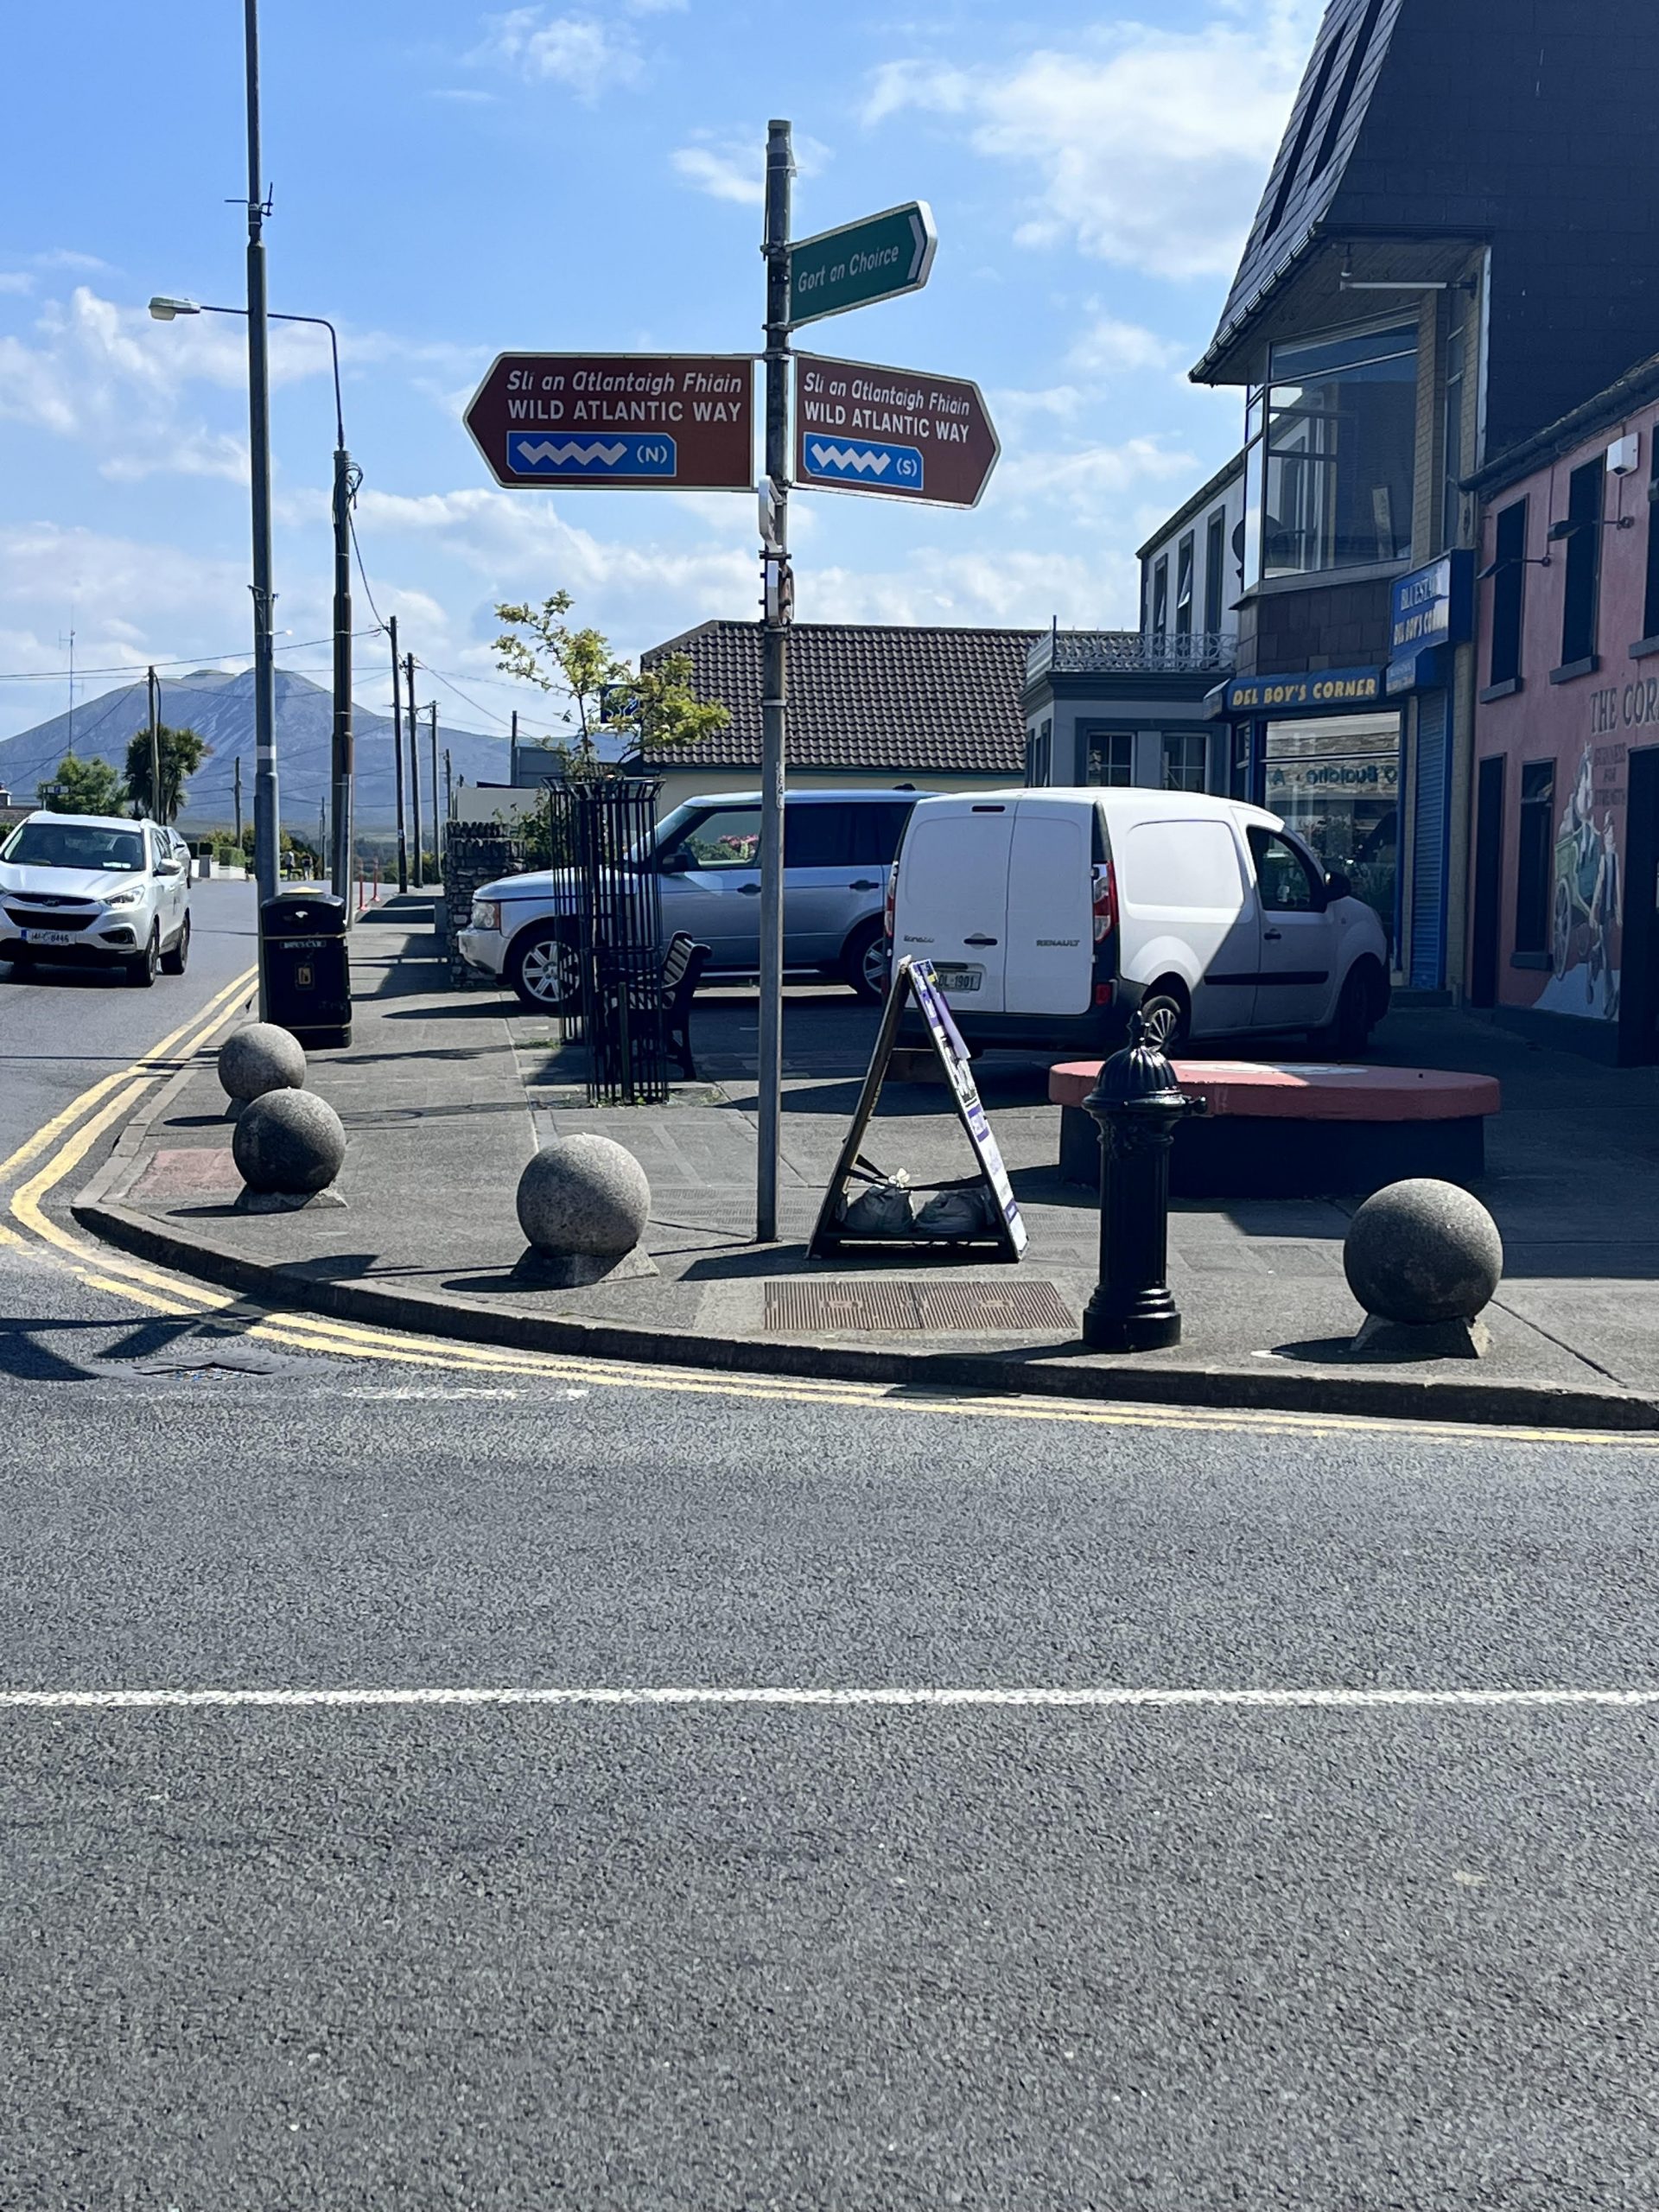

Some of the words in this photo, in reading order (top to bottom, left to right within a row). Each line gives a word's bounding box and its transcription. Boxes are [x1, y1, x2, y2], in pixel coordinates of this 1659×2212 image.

[798, 264, 826, 293] Gort
[830, 264, 845, 283] an
[849, 245, 899, 276] Choirce
[506, 371, 533, 391] Slí
[541, 375, 564, 391] an
[572, 372, 674, 396] Atlantaigh
[683, 372, 742, 393] Fhiáin
[804, 372, 824, 393] Slí
[830, 380, 847, 398] an
[851, 379, 925, 411] Atlantaigh
[928, 391, 969, 416] Fhiáin
[507, 399, 564, 420] WILD
[573, 400, 683, 422] ATLANTIC
[692, 402, 742, 422] WAY
[804, 400, 846, 425] WILD
[851, 408, 930, 438] ATLANTIC
[935, 420, 969, 443] WAY
[637, 445, 668, 464] (N)
[896, 457, 918, 477] (S)
[1232, 688, 1258, 706] DEL
[1263, 684, 1306, 704] BOY'S
[1313, 678, 1376, 699] CORNER
[1590, 688, 1618, 734] THE
[1623, 677, 1659, 726] COR
